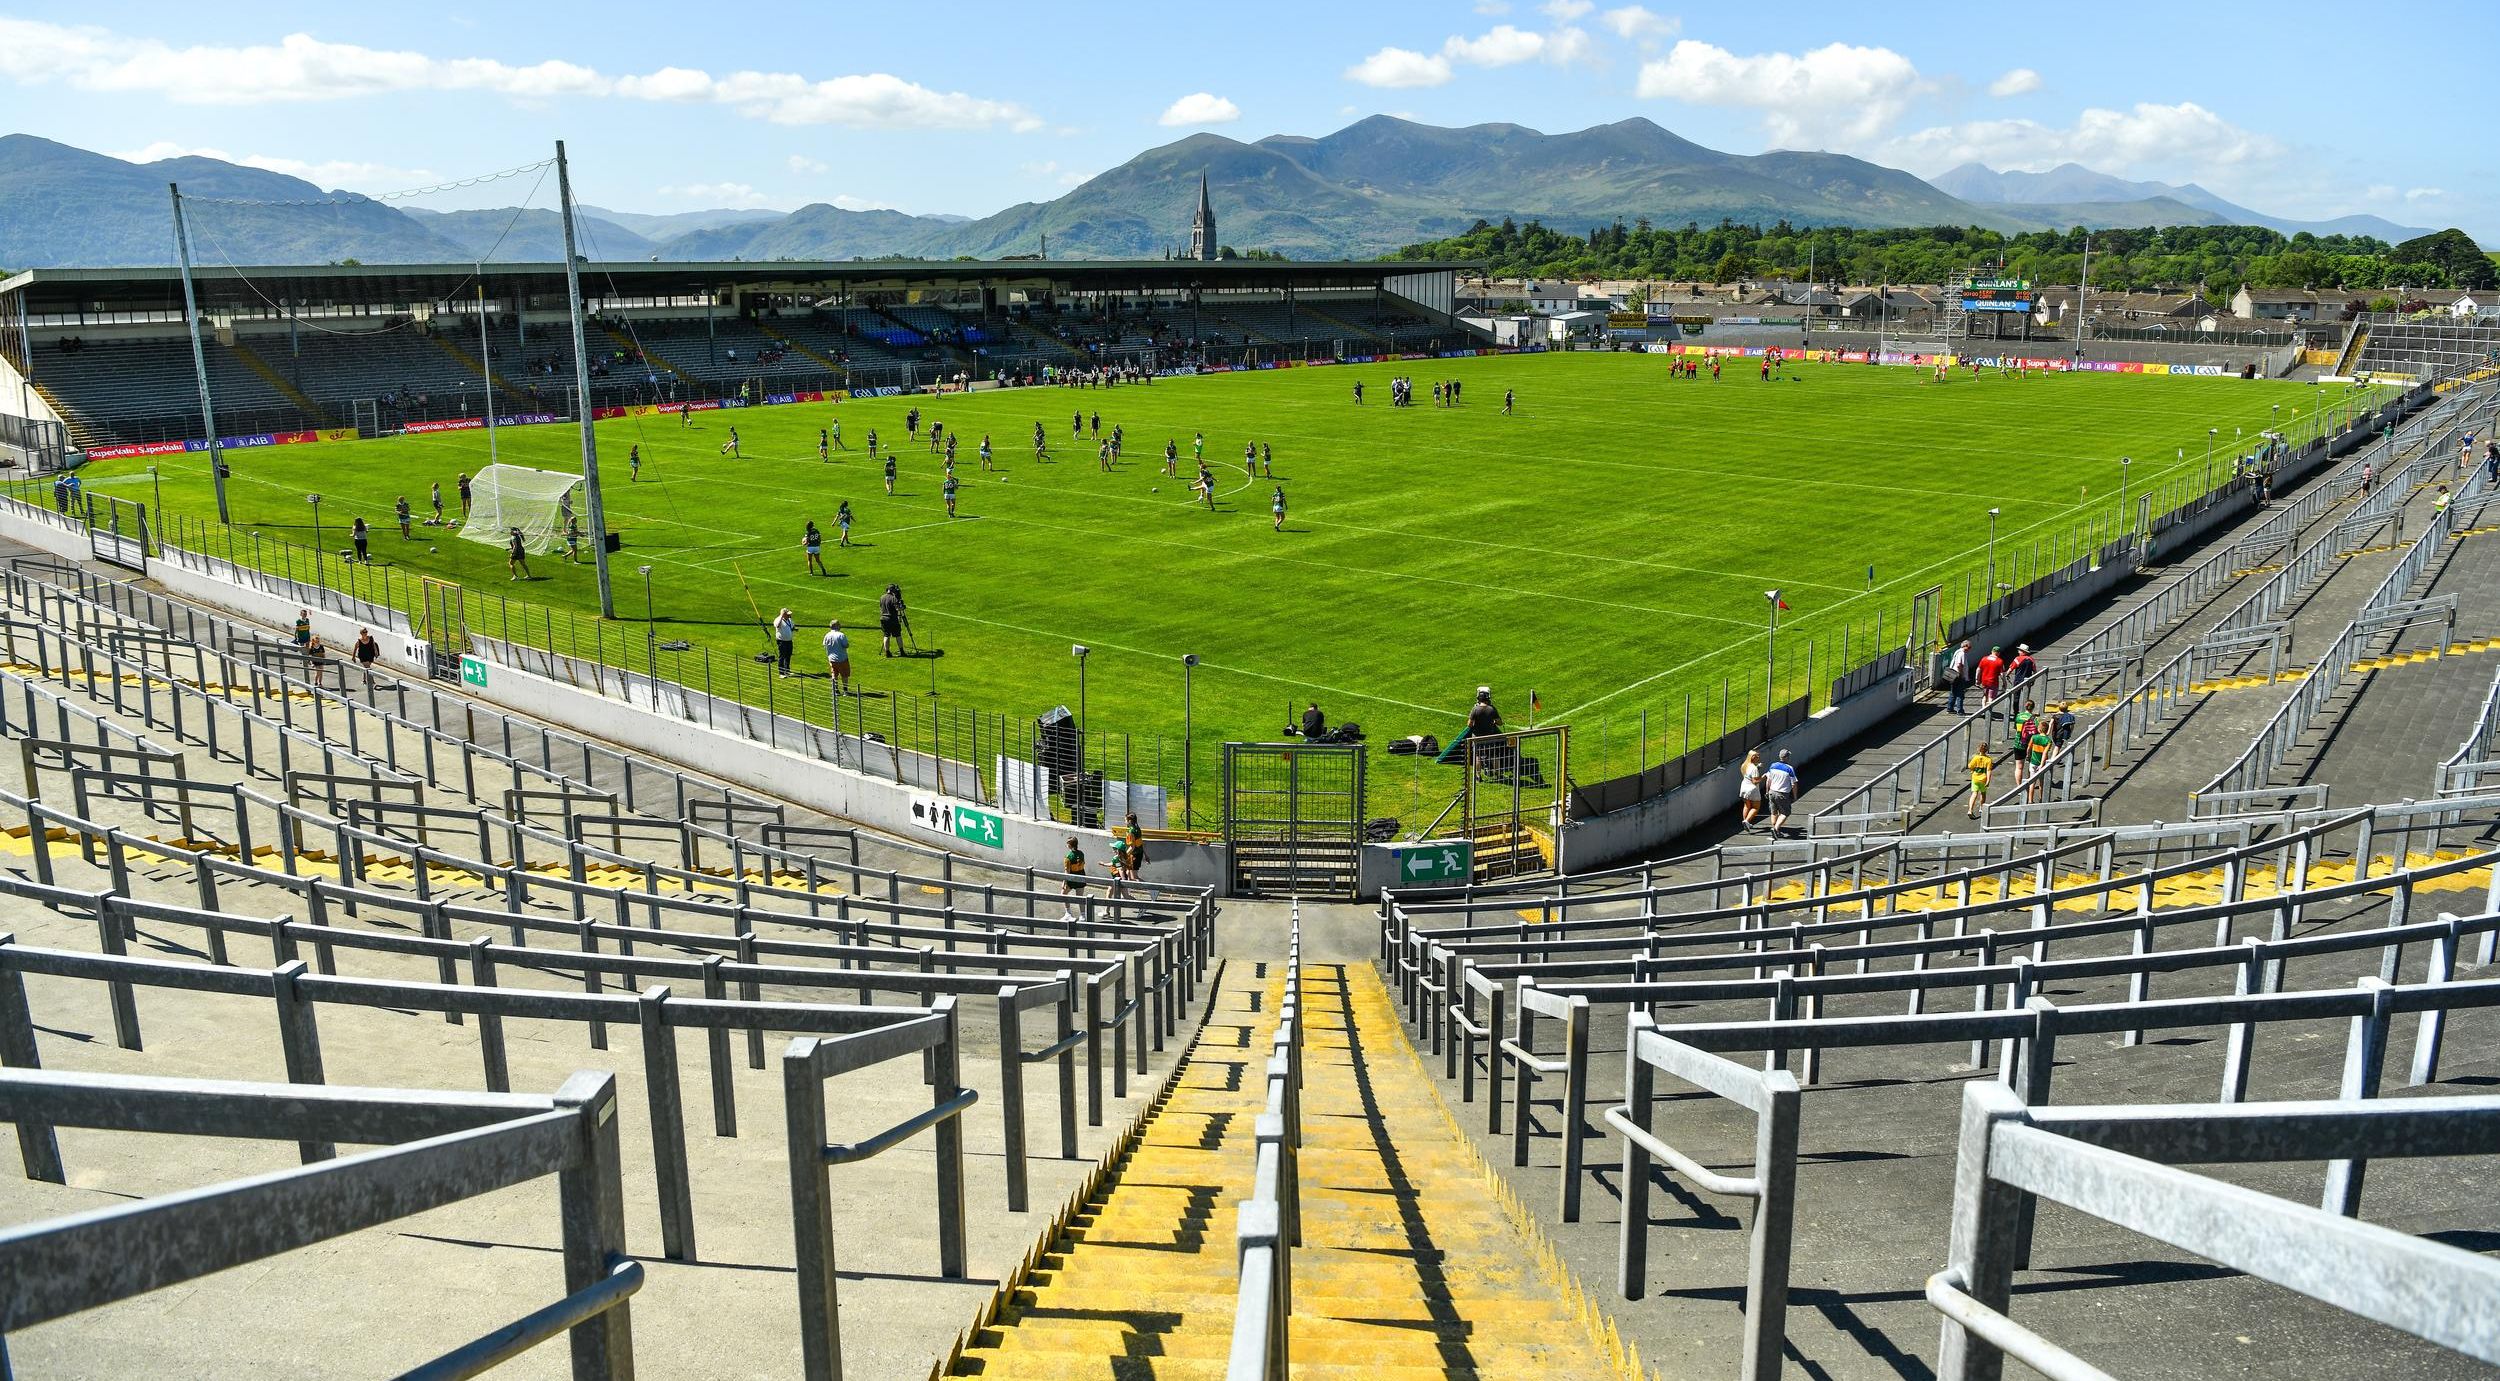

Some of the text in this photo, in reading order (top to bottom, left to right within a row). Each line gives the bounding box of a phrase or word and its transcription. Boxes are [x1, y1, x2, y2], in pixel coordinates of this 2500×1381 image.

[1976, 280, 2018, 288] QUINLAN'S
[1975, 300, 2017, 308] QUINLAN'S
[1976, 357, 1995, 367] GAA
[2078, 362, 2092, 370] AIB
[2170, 364, 2193, 374] GAA
[2196, 366, 2218, 375] GAA
[855, 387, 873, 398] GAA
[880, 386, 899, 397] GAA
[779, 396, 792, 404] AIB
[689, 402, 719, 411] SuperValu
[498, 416, 515, 426] AIB
[534, 414, 551, 424] AIB
[407, 423, 444, 433] SuperValu
[446, 420, 482, 430] SuperValu
[287, 432, 304, 444] eir
[329, 429, 347, 441] eir
[204, 440, 224, 449] AB
[250, 436, 268, 446] AIB
[89, 448, 136, 459] SuperValu
[138, 443, 183, 455] SuperValu
